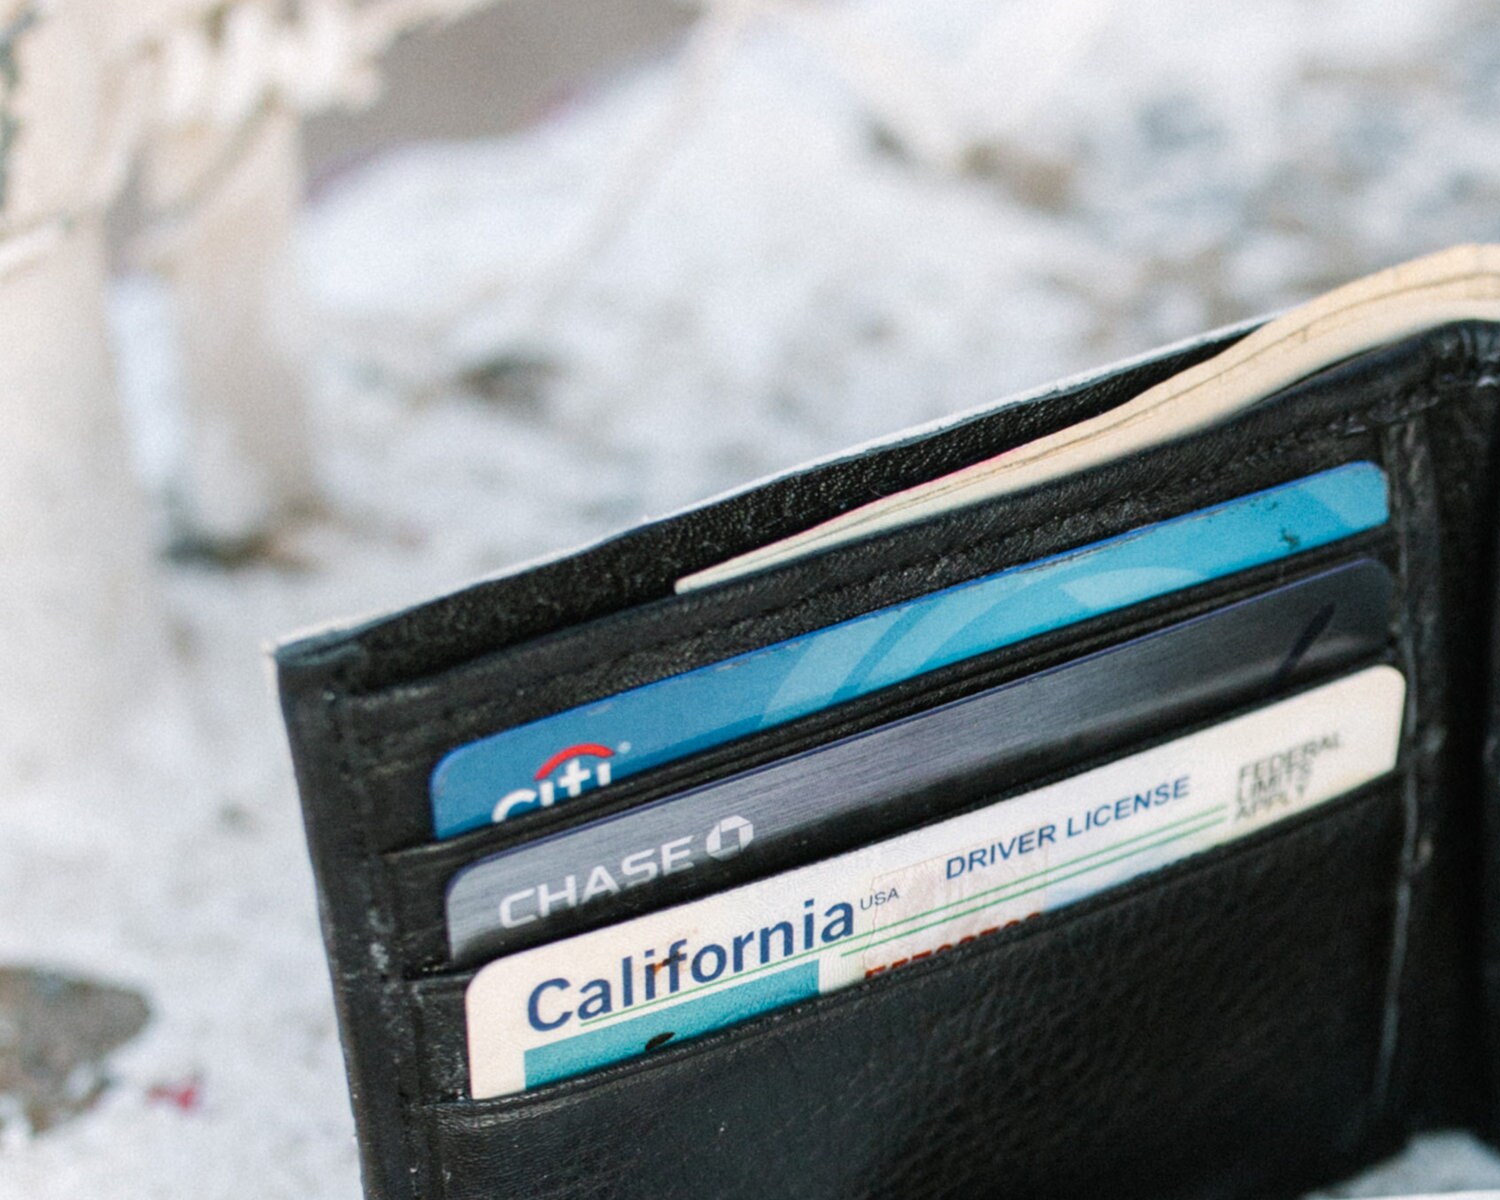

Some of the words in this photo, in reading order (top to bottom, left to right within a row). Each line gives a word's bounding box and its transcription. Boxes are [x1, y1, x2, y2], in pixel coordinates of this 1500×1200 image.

[1236, 763, 1312, 805] LIMITS
[1238, 731, 1341, 781] FEDERAL
[500, 835, 697, 929] CHASE
[527, 899, 855, 1033] California
[860, 887, 900, 912] USA
[946, 824, 1057, 881] DRIVER
[1067, 775, 1191, 838] LICENSE
